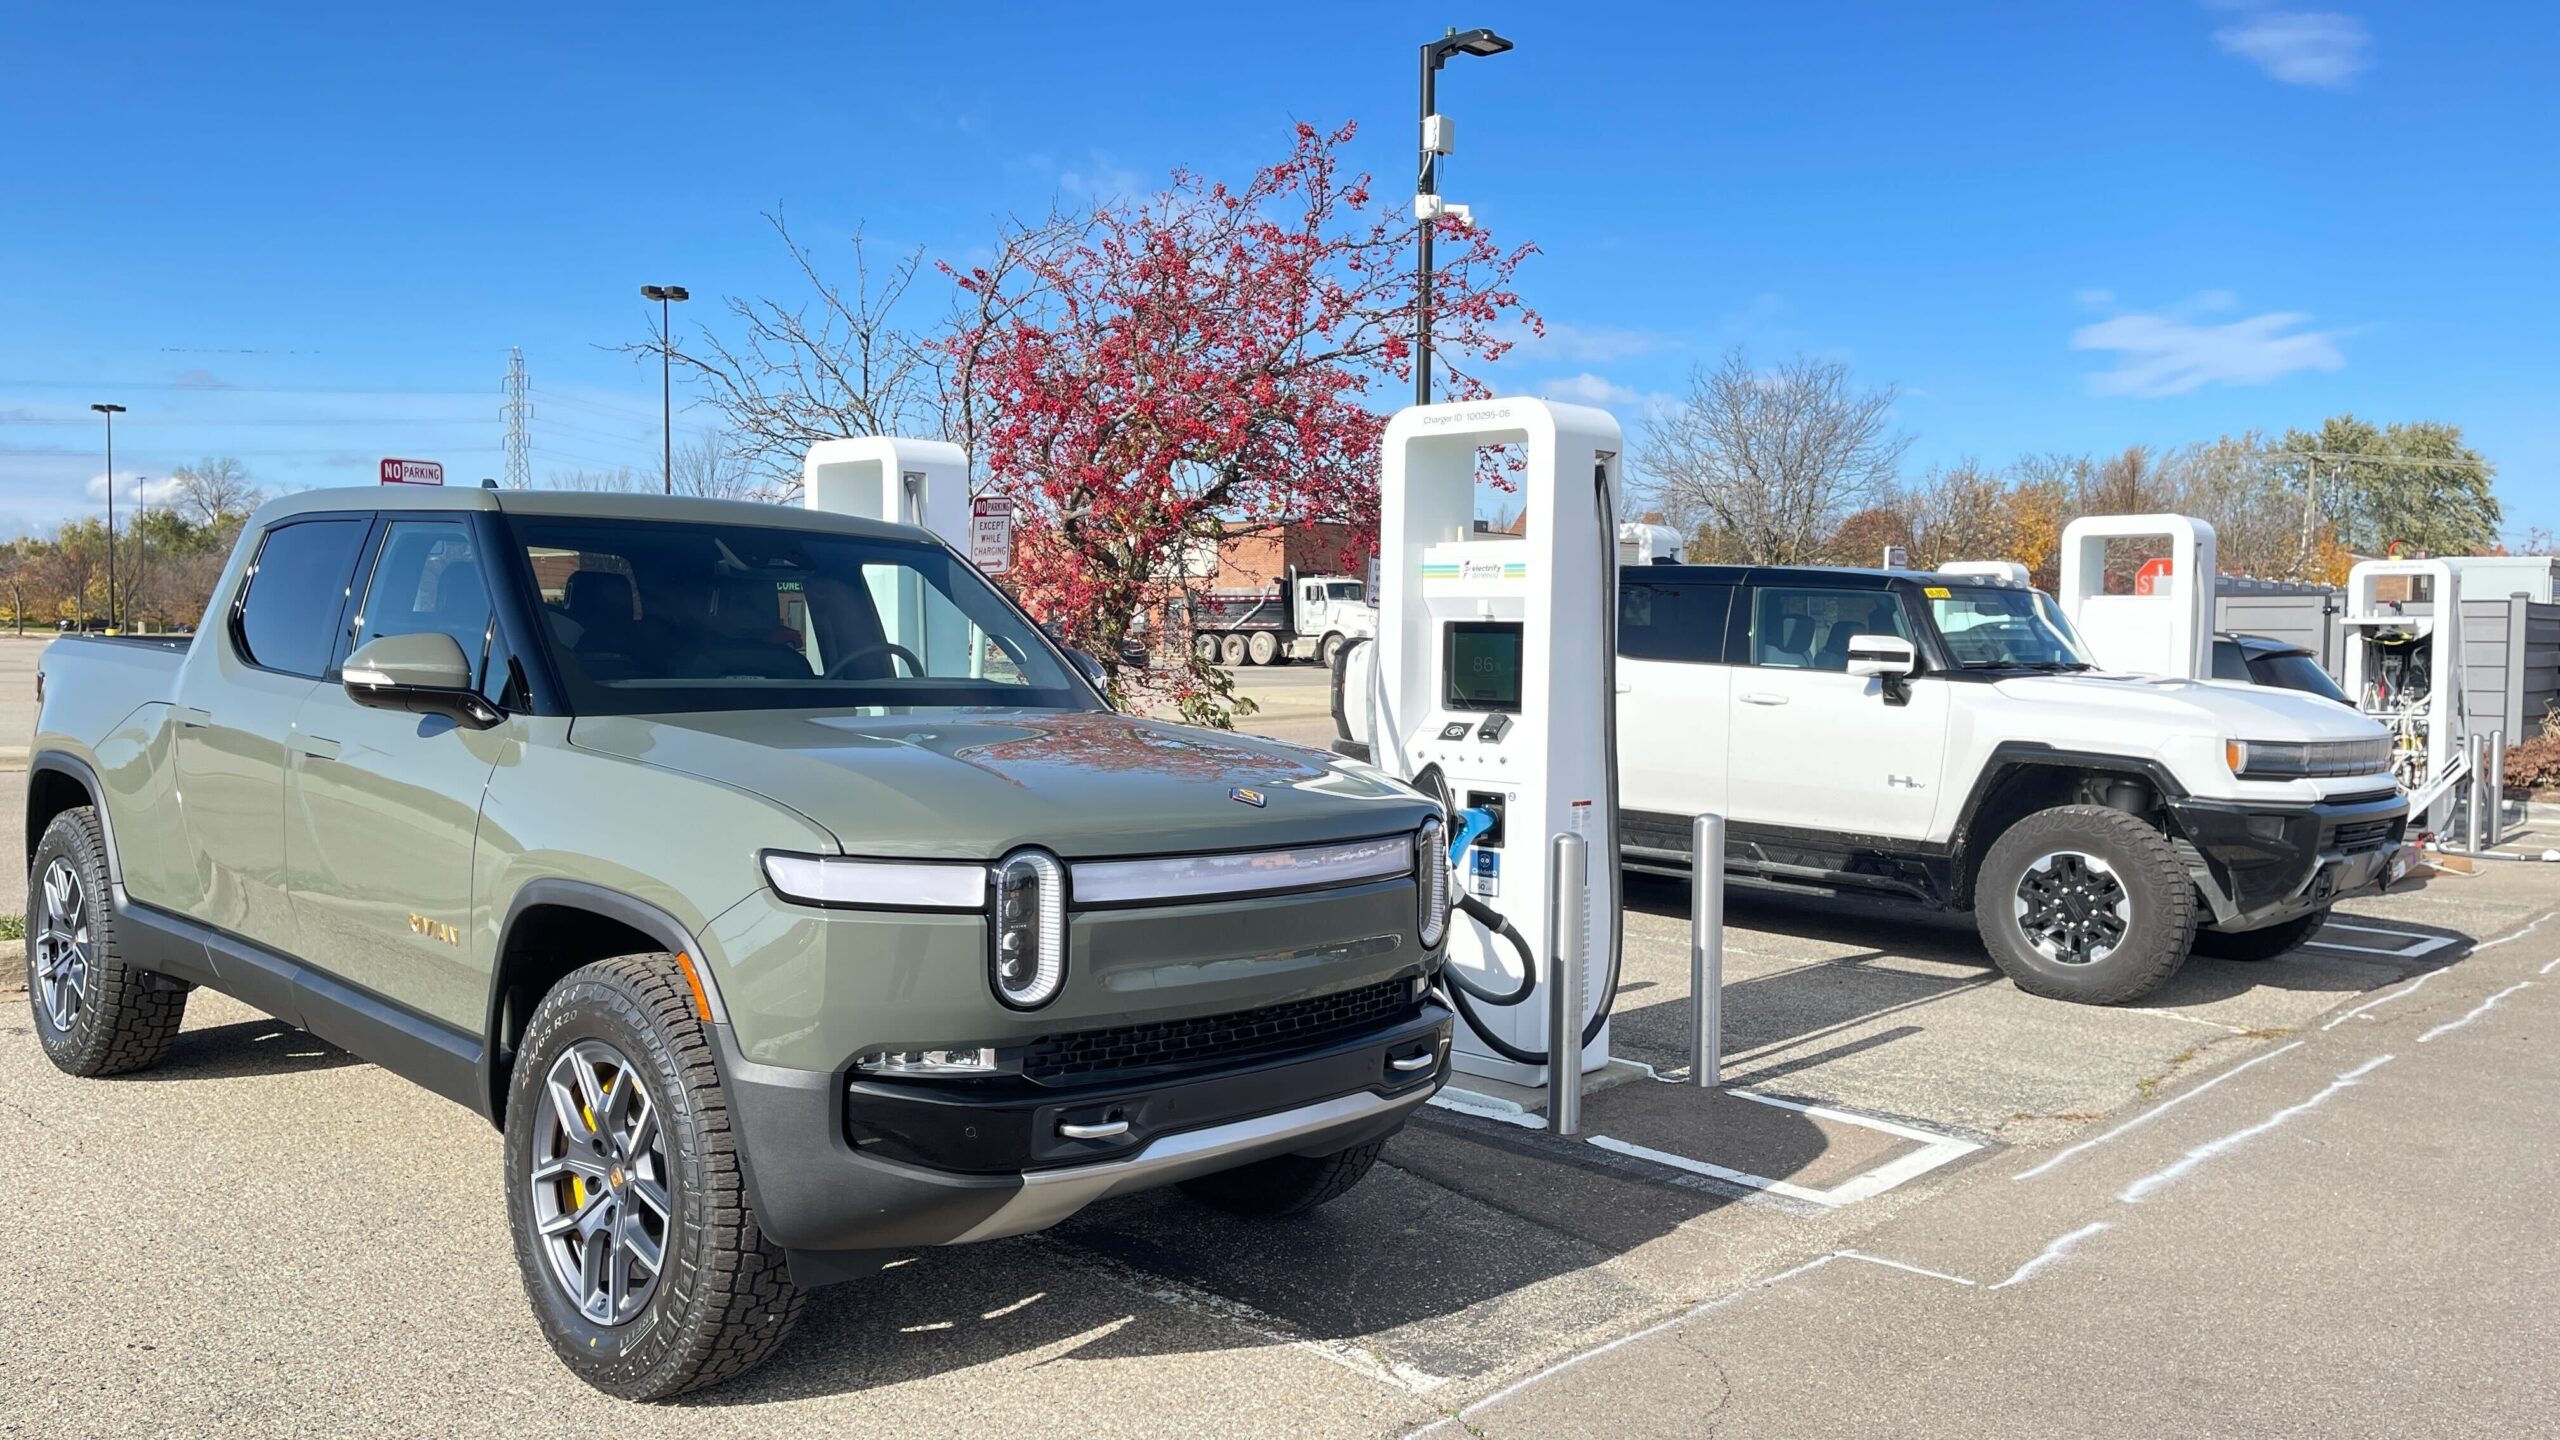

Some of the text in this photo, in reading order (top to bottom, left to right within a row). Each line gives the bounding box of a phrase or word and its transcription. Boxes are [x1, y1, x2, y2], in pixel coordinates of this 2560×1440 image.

[1423, 415, 1453, 425] Charger
[1454, 413, 1463, 422] ID
[384, 462, 440, 480] NO PARKING
[976, 500, 1010, 514] NO PARKING
[979, 521, 1005, 531] EXCEPT
[981, 533, 1001, 543] WHILE
[974, 546, 1007, 556] CHARGING
[554, 1009, 578, 1030] R20
